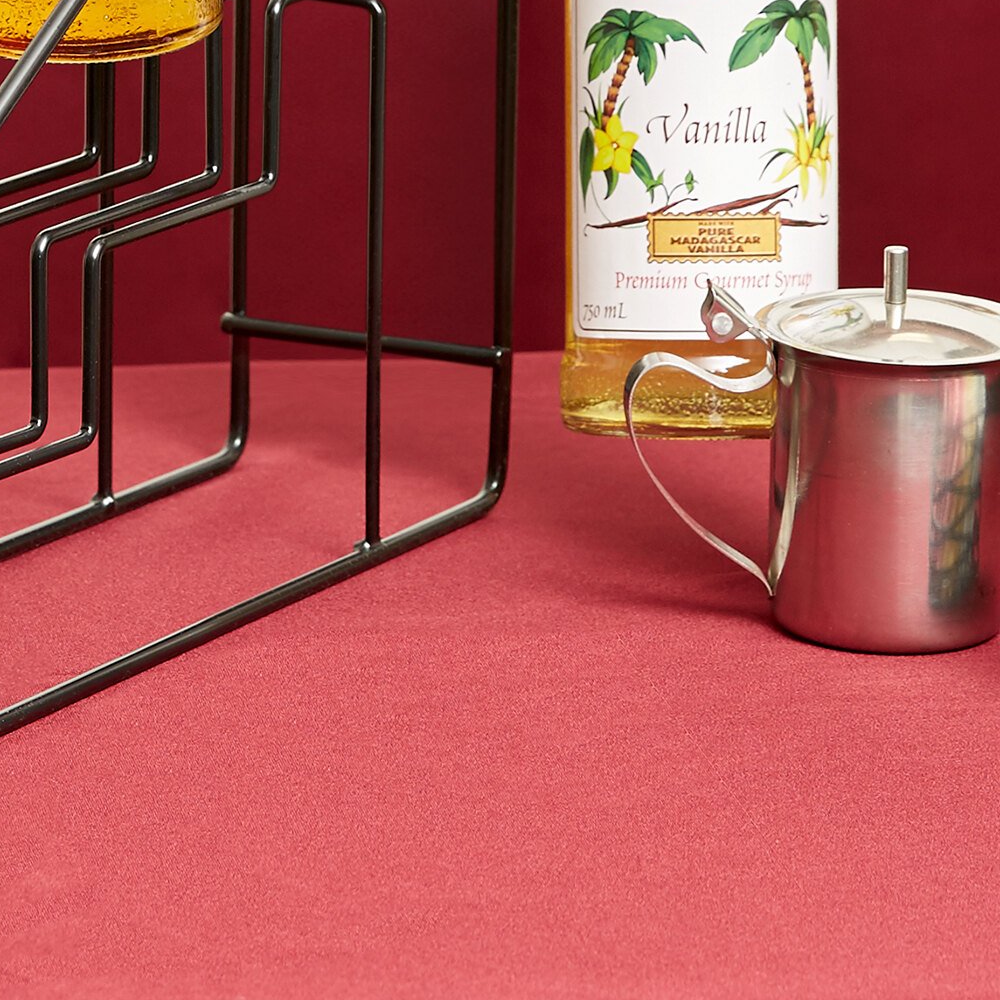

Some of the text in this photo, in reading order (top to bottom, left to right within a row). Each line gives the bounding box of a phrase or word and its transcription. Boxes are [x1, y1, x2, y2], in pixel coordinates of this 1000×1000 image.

[646, 103, 767, 144] Vanilla
[698, 227, 734, 236] PURE
[670, 235, 761, 245] MADAGASCAR
[687, 245, 745, 253] VANILLA
[615, 270, 688, 289] Premium
[774, 270, 813, 296] Syrup
[583, 302, 628, 321] 750 mL
